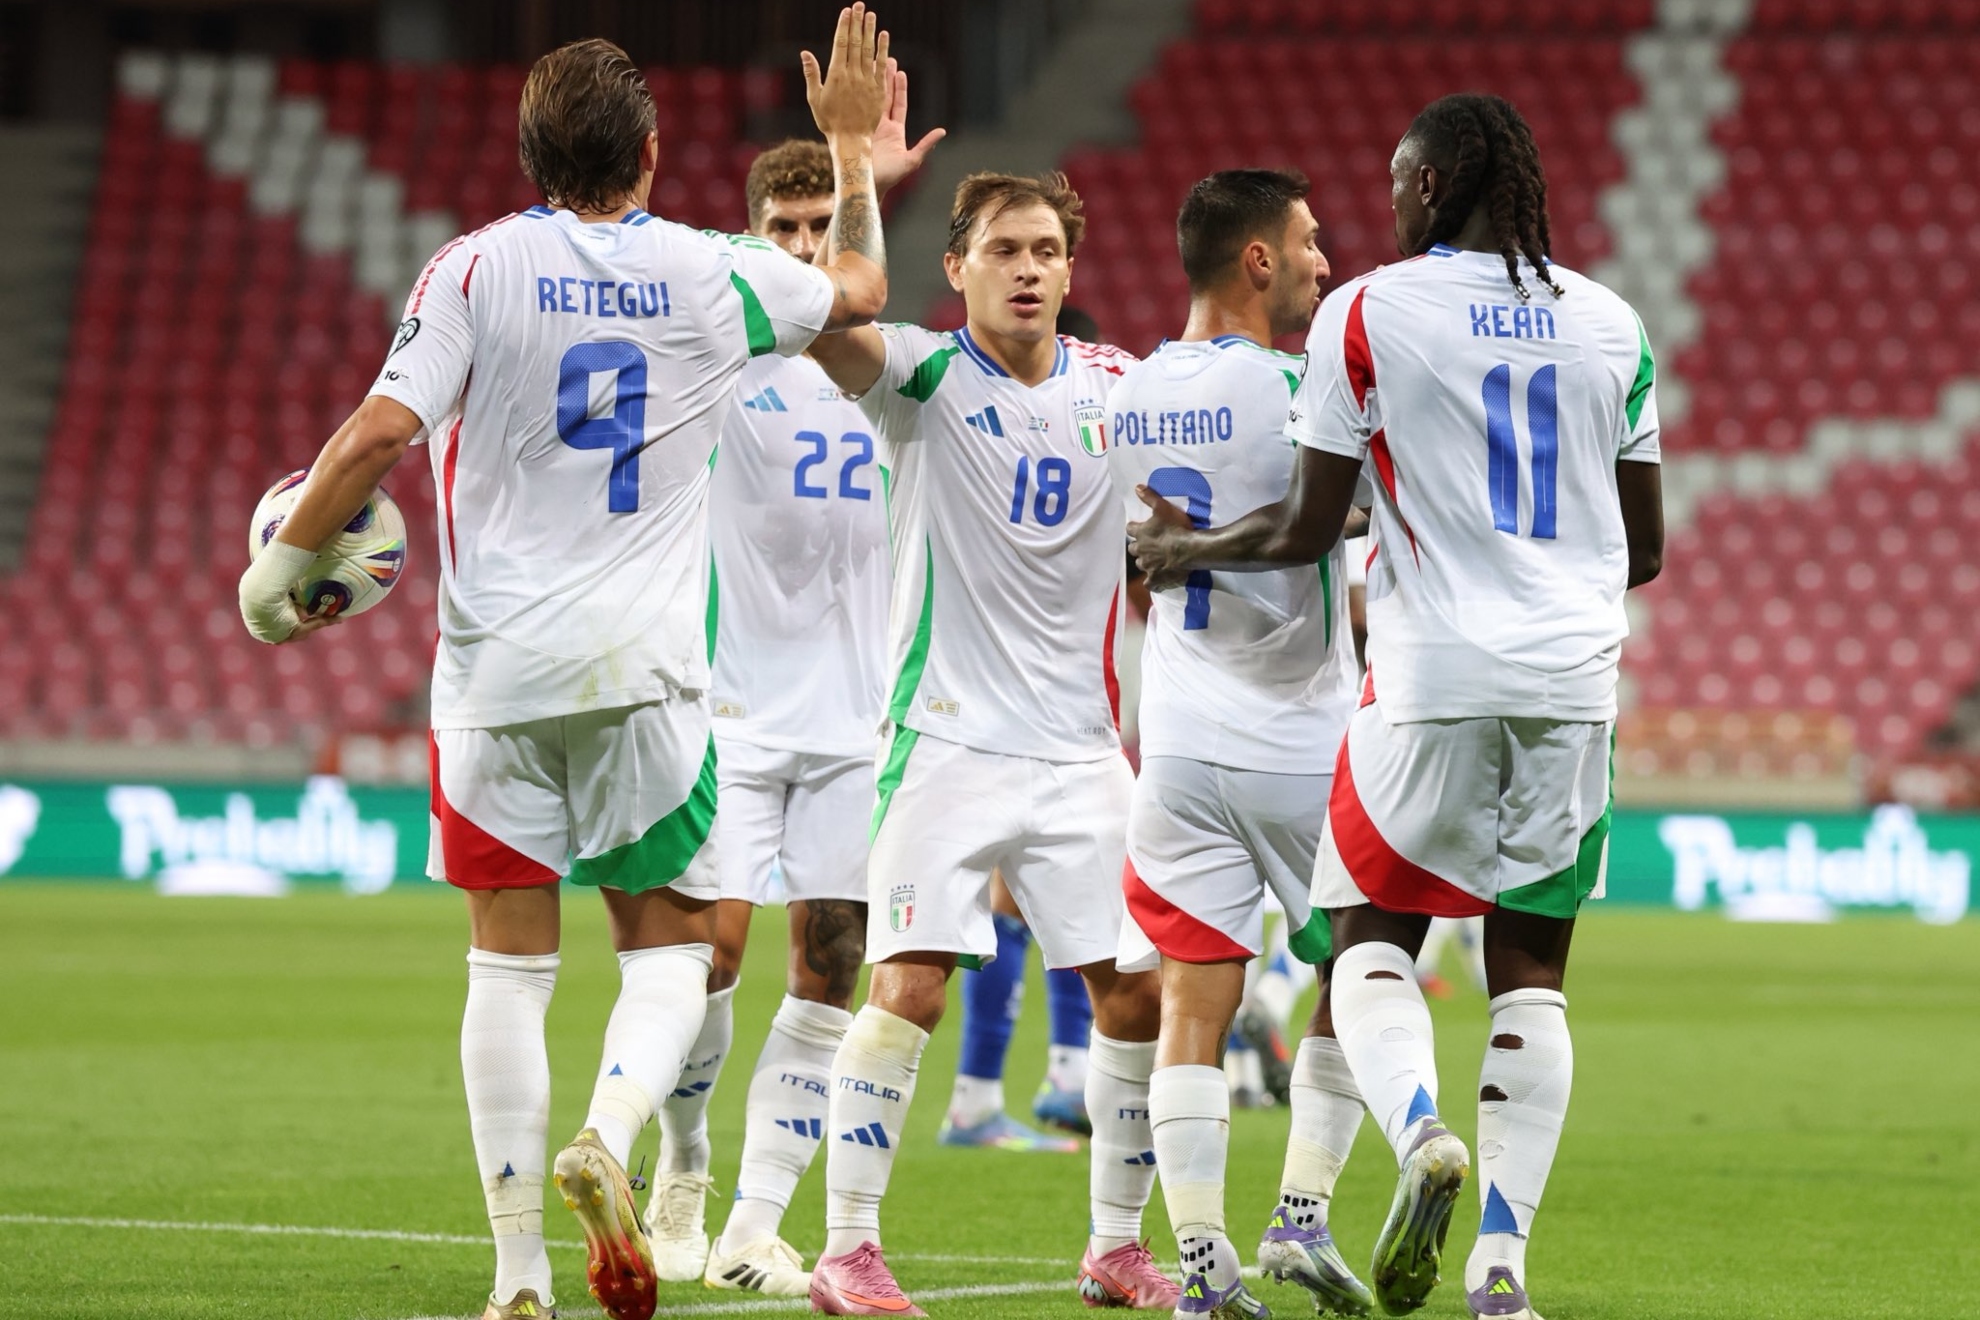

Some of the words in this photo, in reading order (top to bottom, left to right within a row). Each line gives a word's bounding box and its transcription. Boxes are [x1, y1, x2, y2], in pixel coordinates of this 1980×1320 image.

[537, 276, 671, 318] RETEGUI
[1469, 303, 1557, 339] KEAN
[556, 340, 649, 513] 9
[1076, 409, 1104, 422] ITALIA
[1114, 406, 1233, 448] POLITANO
[794, 431, 874, 501] 22
[1481, 363, 1559, 540] 11
[1010, 455, 1072, 527] 18
[892, 893, 913, 904] ITALIA
[780, 1073, 829, 1098] ITAL
[839, 1076, 901, 1102] ITALIA
